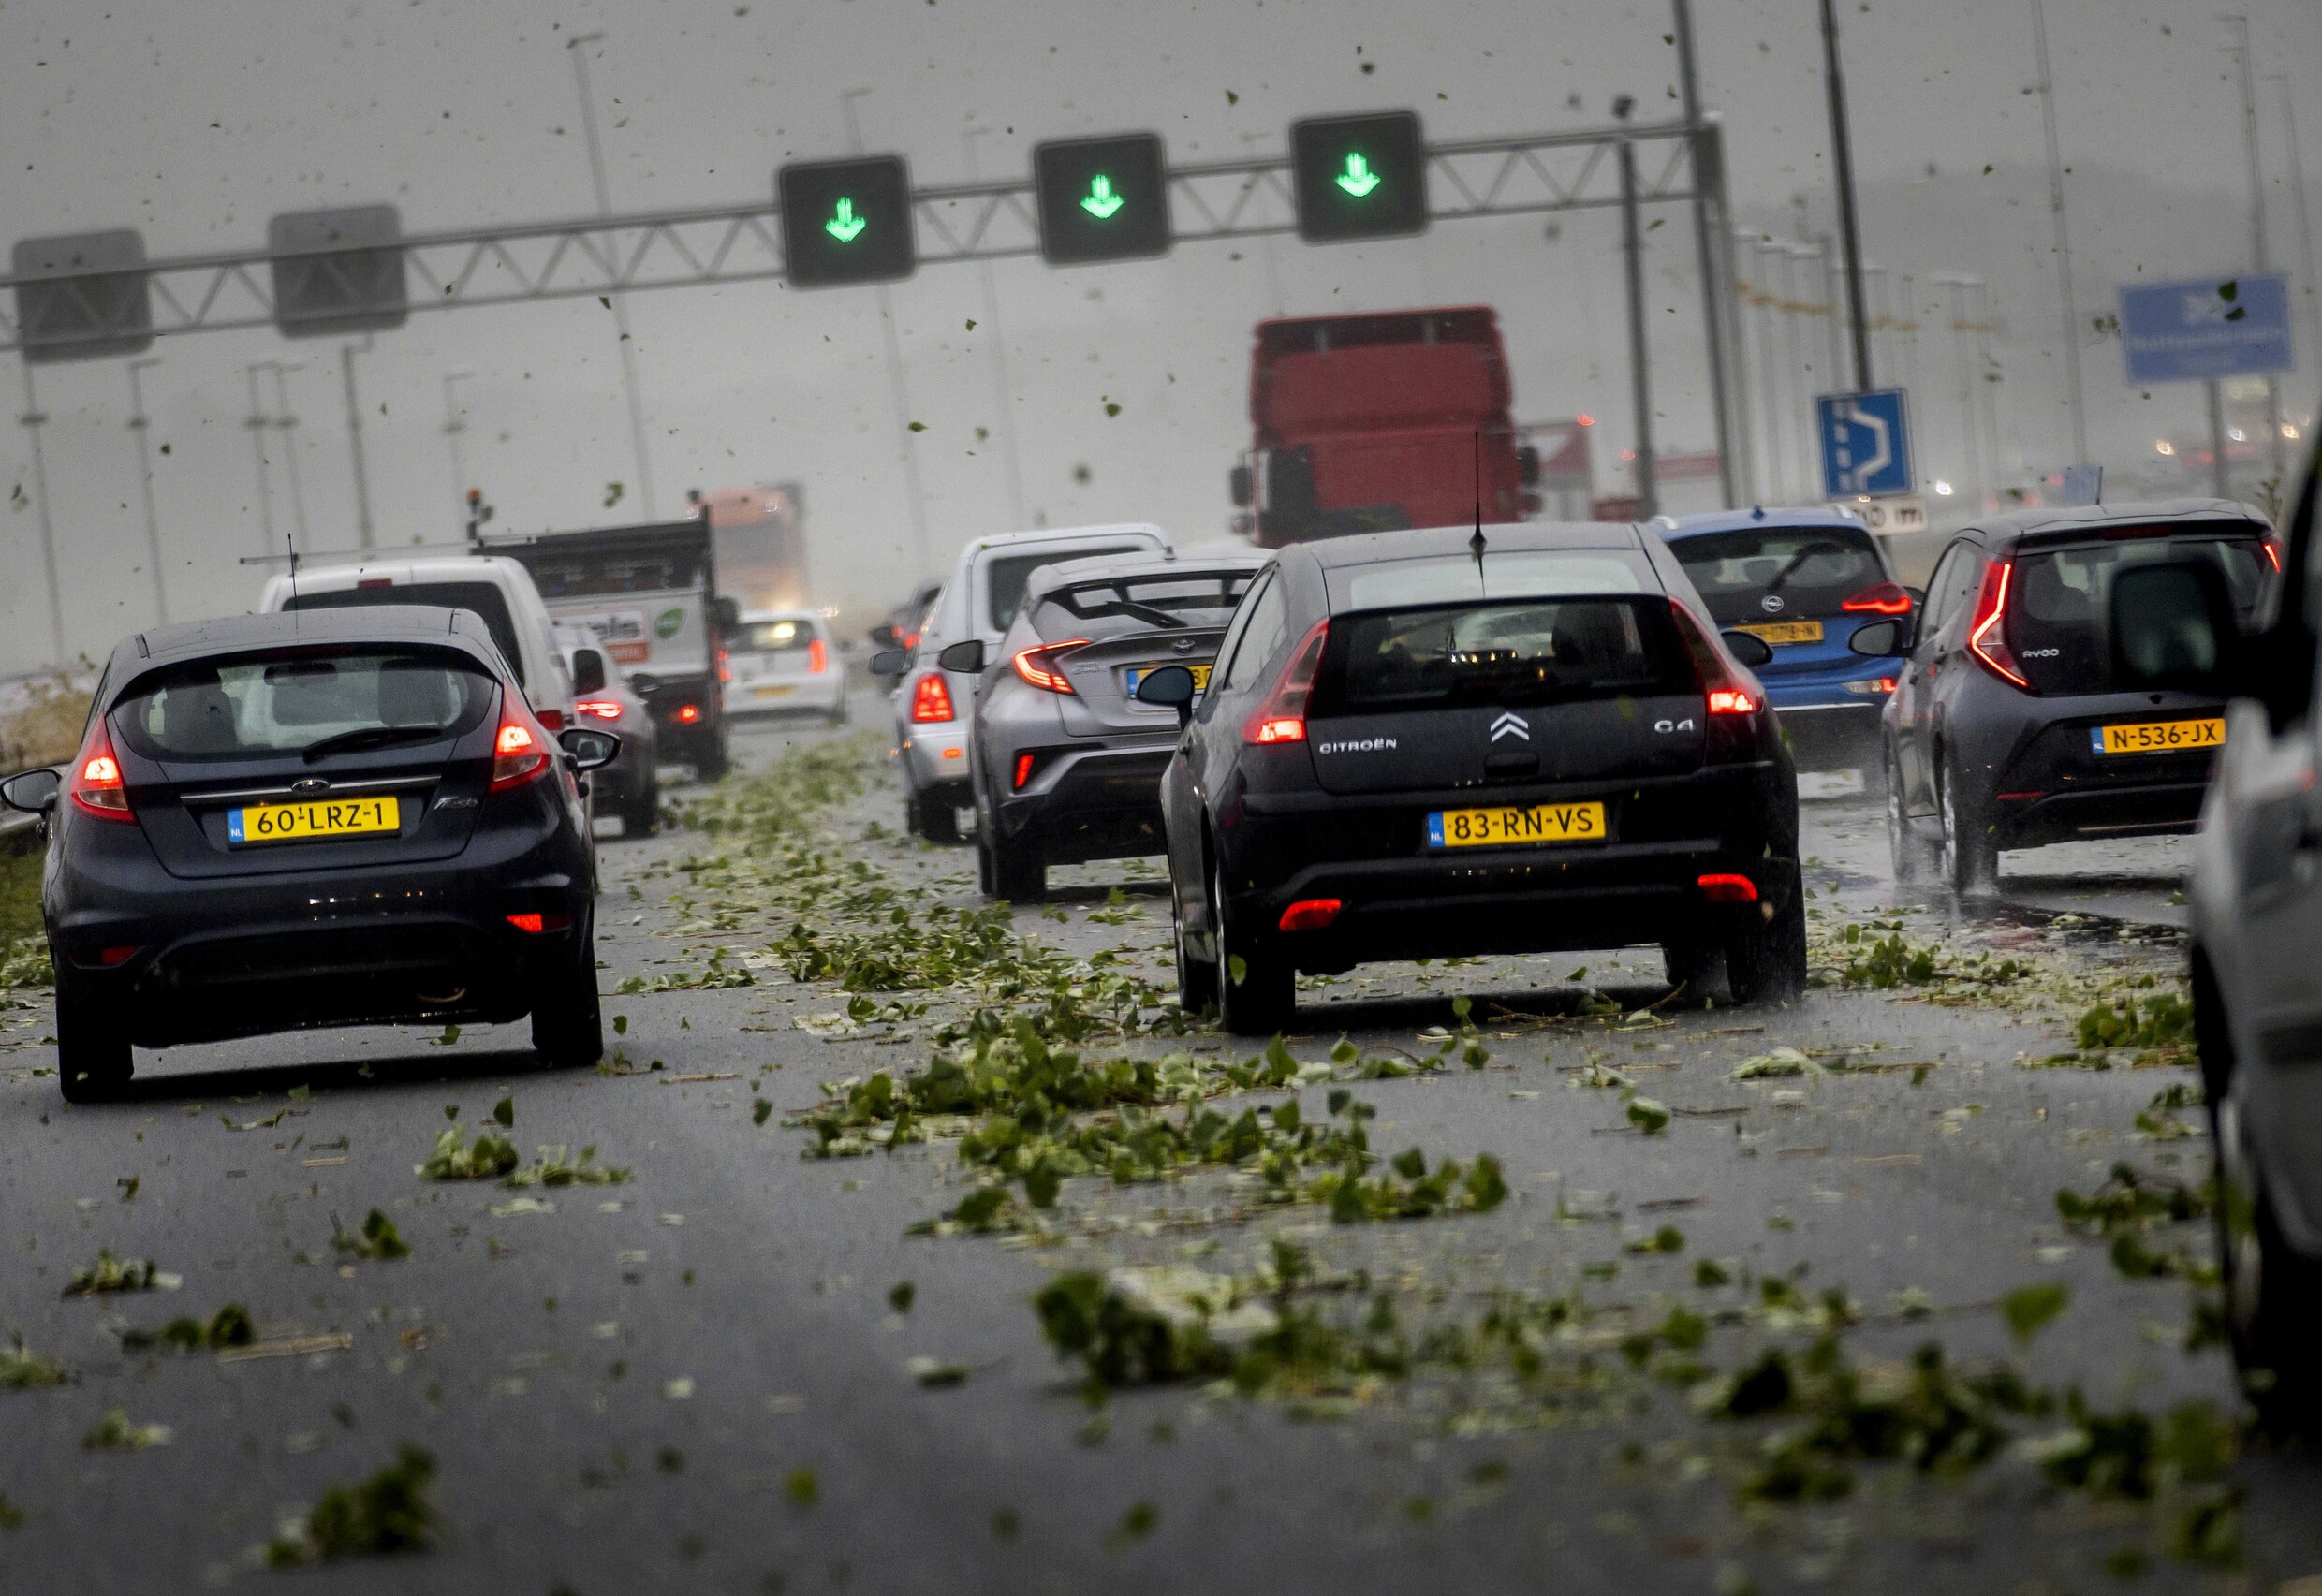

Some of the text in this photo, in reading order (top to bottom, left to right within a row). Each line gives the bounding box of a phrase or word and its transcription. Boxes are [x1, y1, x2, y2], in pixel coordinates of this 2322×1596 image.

[1654, 718, 1694, 734] C4
[2112, 723, 2217, 749] N-536-JX
[1319, 737, 1397, 754] CITROËN
[1430, 807, 1594, 841] NL 83-RN-VS
[231, 829, 242, 838] NL
